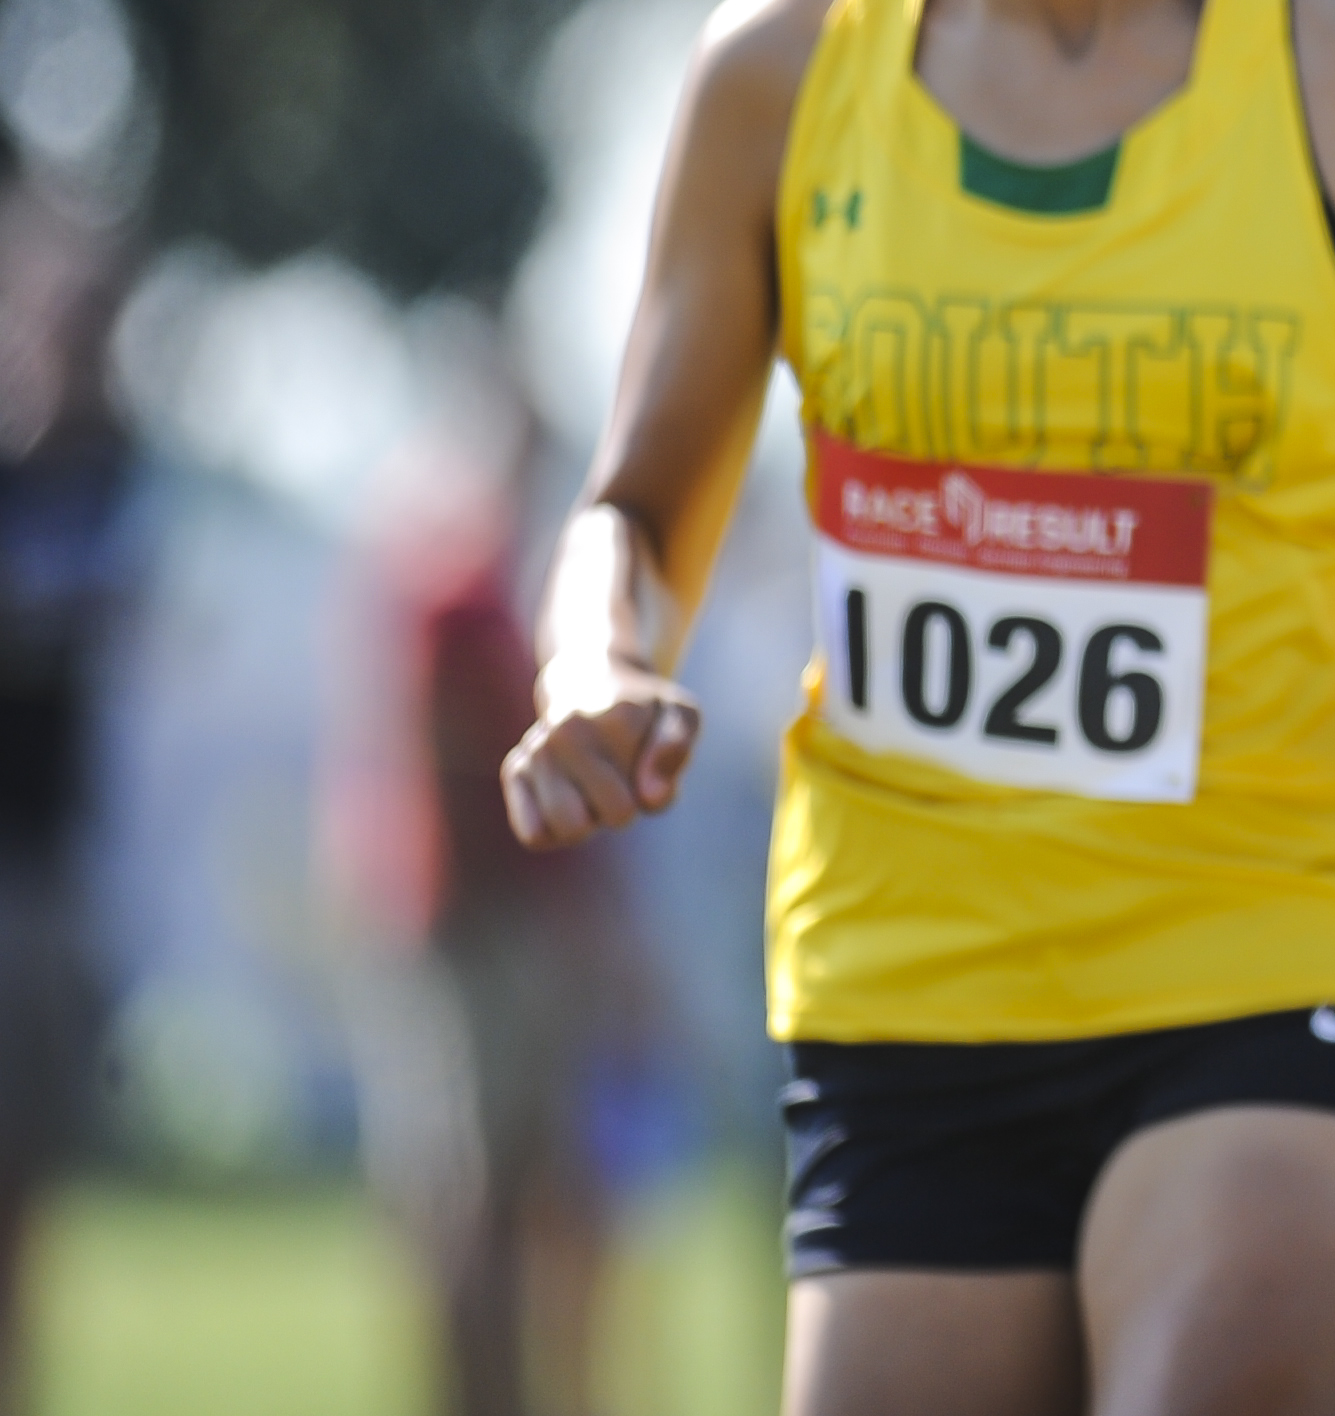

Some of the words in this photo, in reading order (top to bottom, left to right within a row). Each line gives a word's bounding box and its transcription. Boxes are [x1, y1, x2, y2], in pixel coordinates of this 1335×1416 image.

[842, 478, 939, 536] RACE
[985, 500, 1138, 557] RESULT
[847, 588, 1163, 753] 1026
